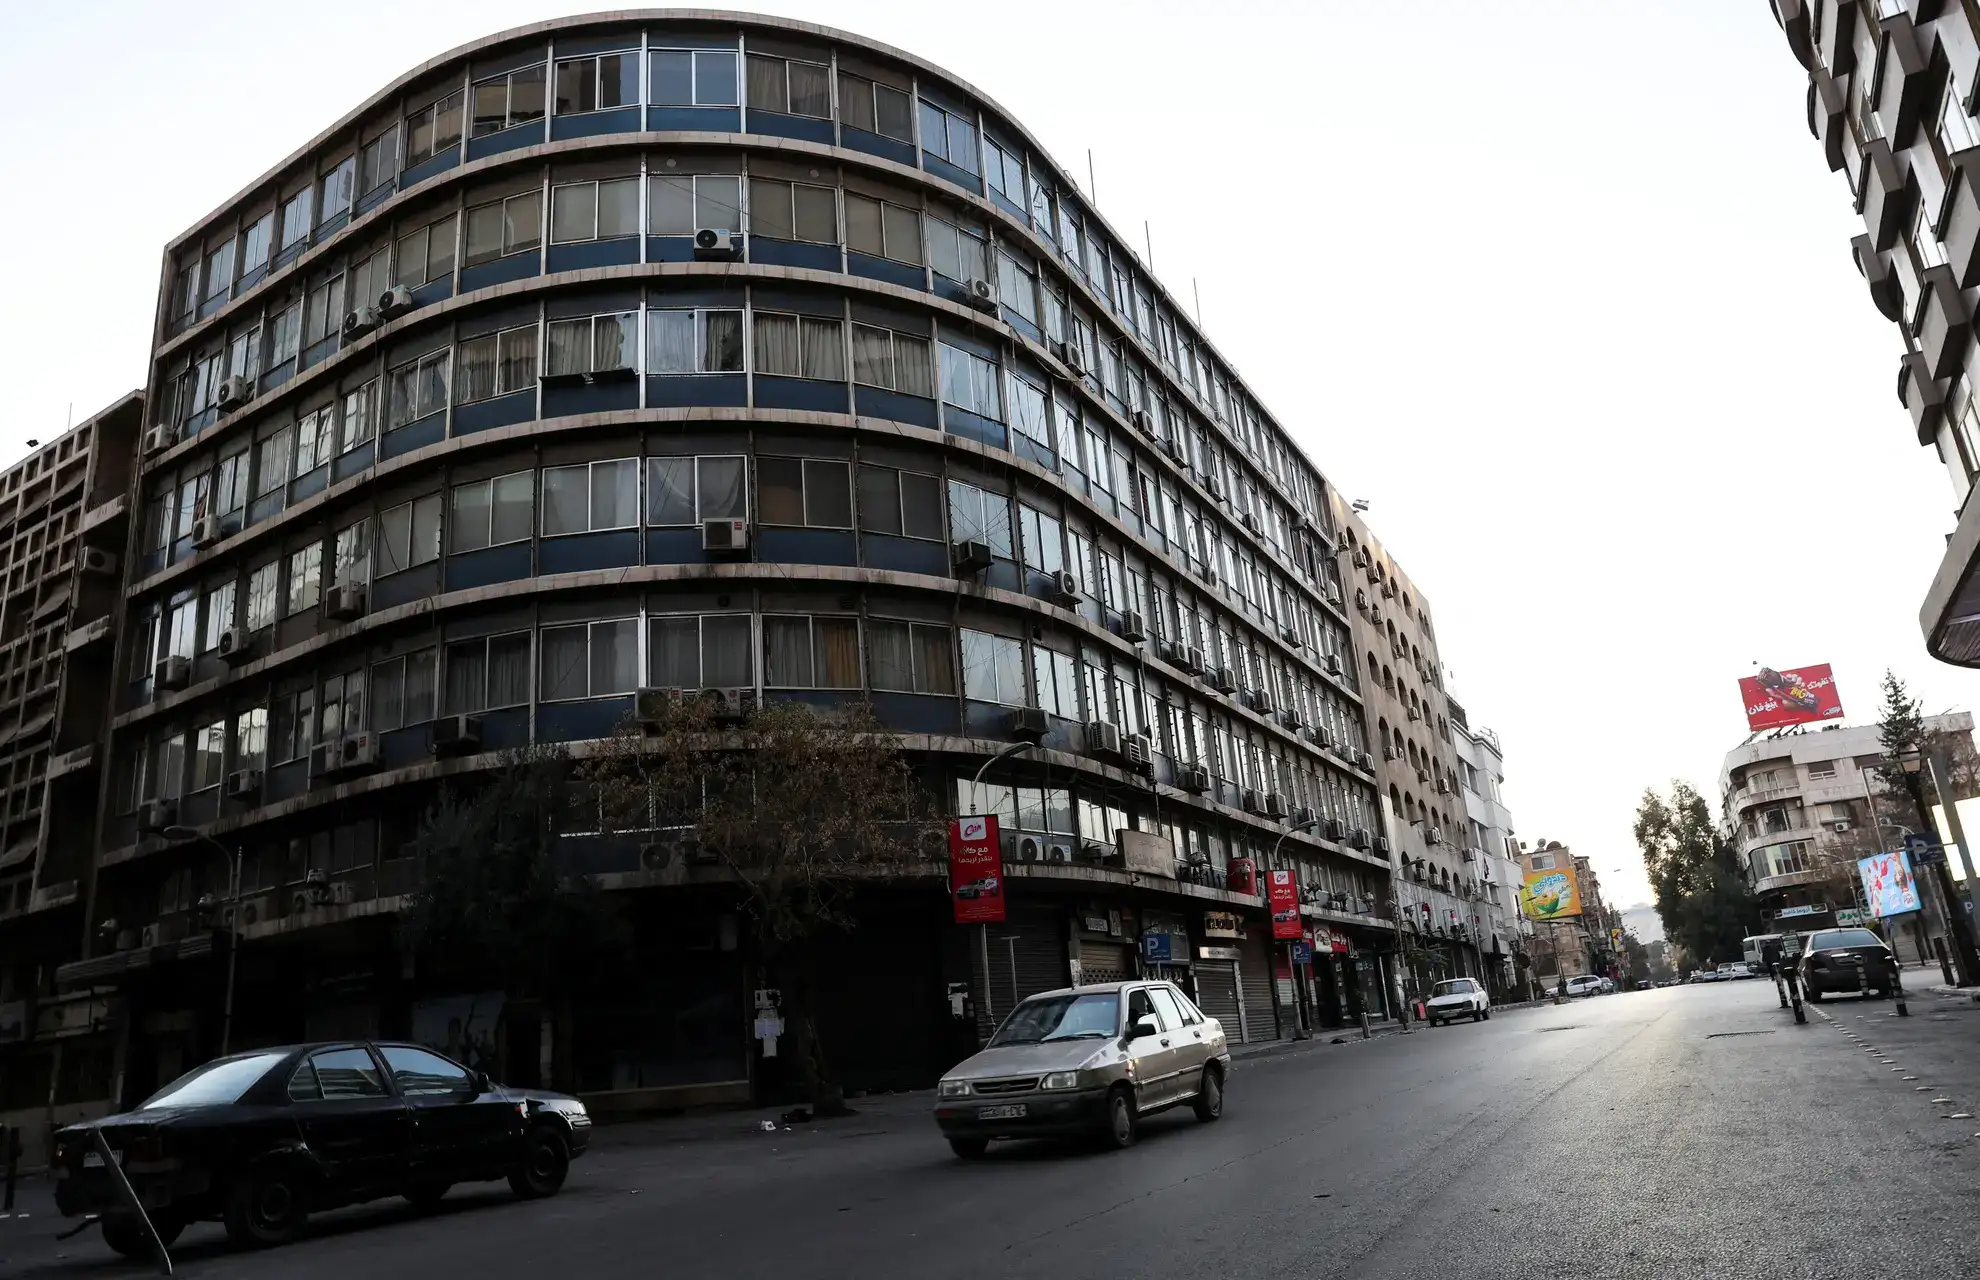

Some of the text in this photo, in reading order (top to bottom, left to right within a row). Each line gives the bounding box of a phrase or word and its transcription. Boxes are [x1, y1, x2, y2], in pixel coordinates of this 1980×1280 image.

[978, 846, 988, 855] مع
[1911, 839, 1929, 862] P
[1964, 902, 1974, 914] P
[1147, 937, 1159, 956] P
[1293, 945, 1303, 960] P
